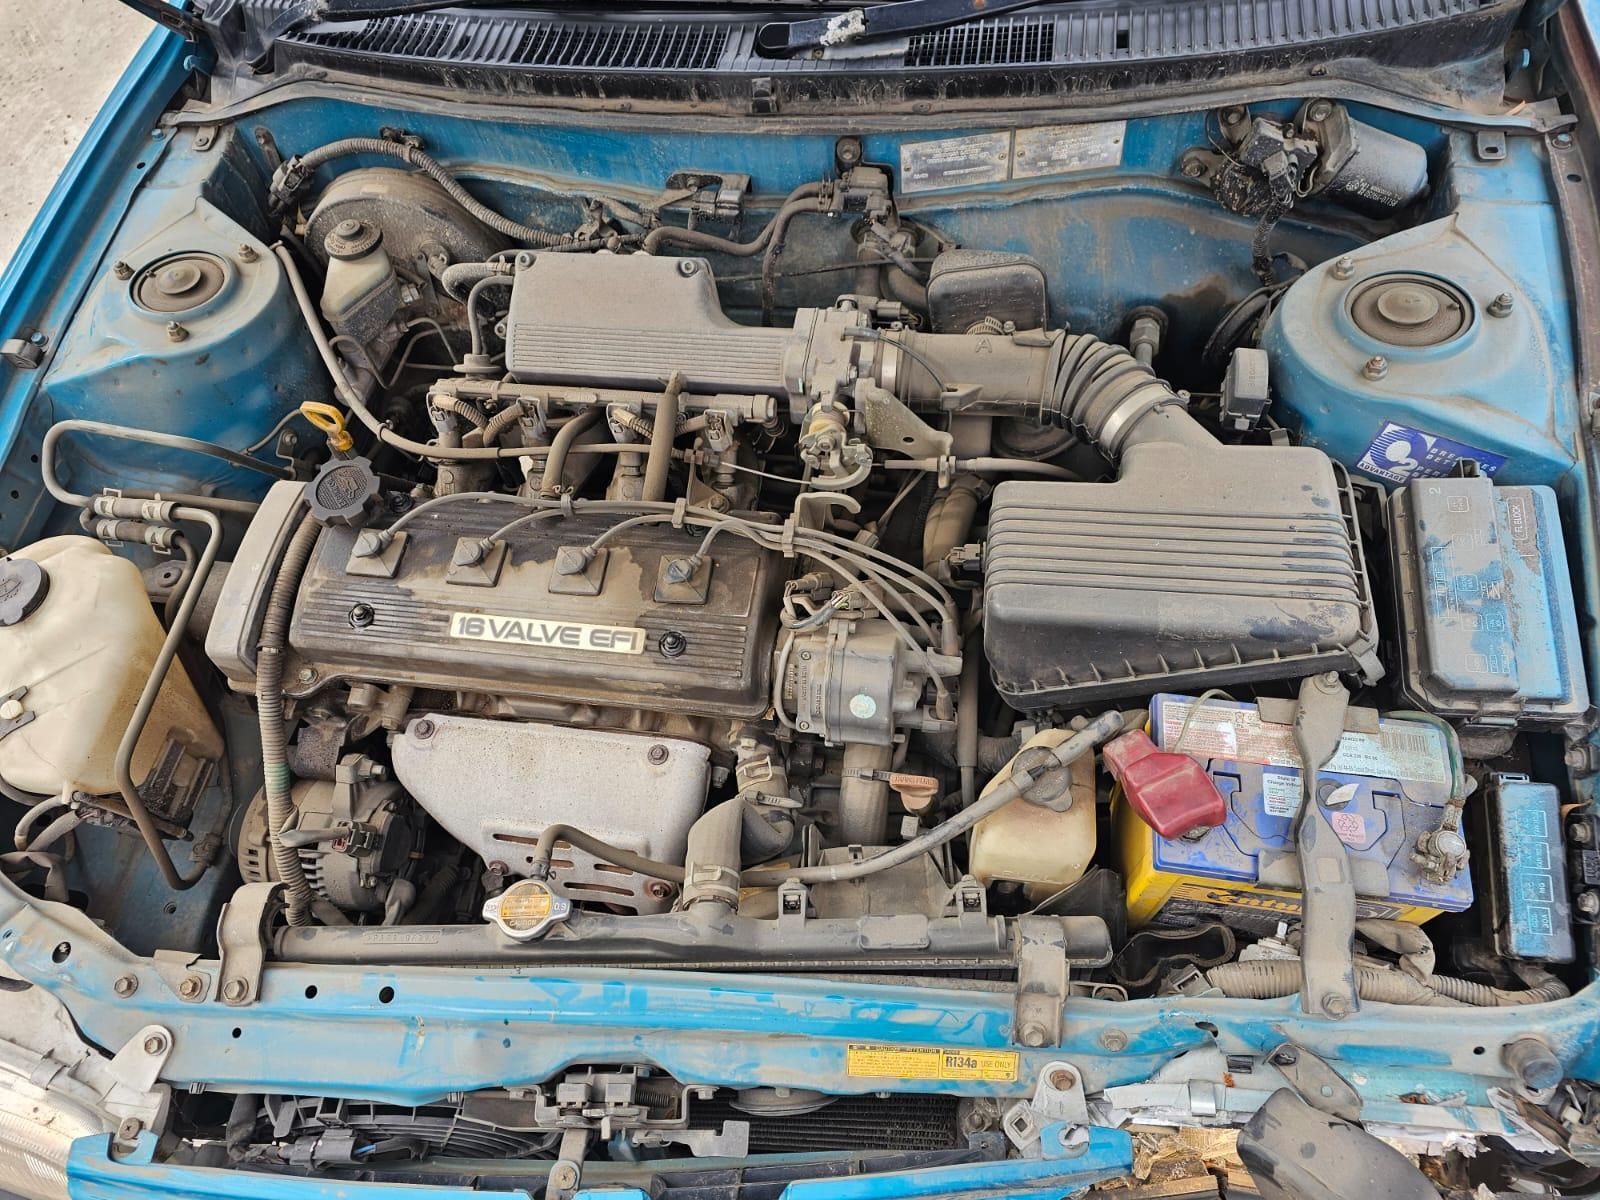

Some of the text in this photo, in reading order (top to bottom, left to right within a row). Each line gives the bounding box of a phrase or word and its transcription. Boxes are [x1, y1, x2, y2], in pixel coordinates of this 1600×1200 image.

[458, 616, 638, 652] 16 VALVE EFI
[945, 1056, 978, 1069] R134a
